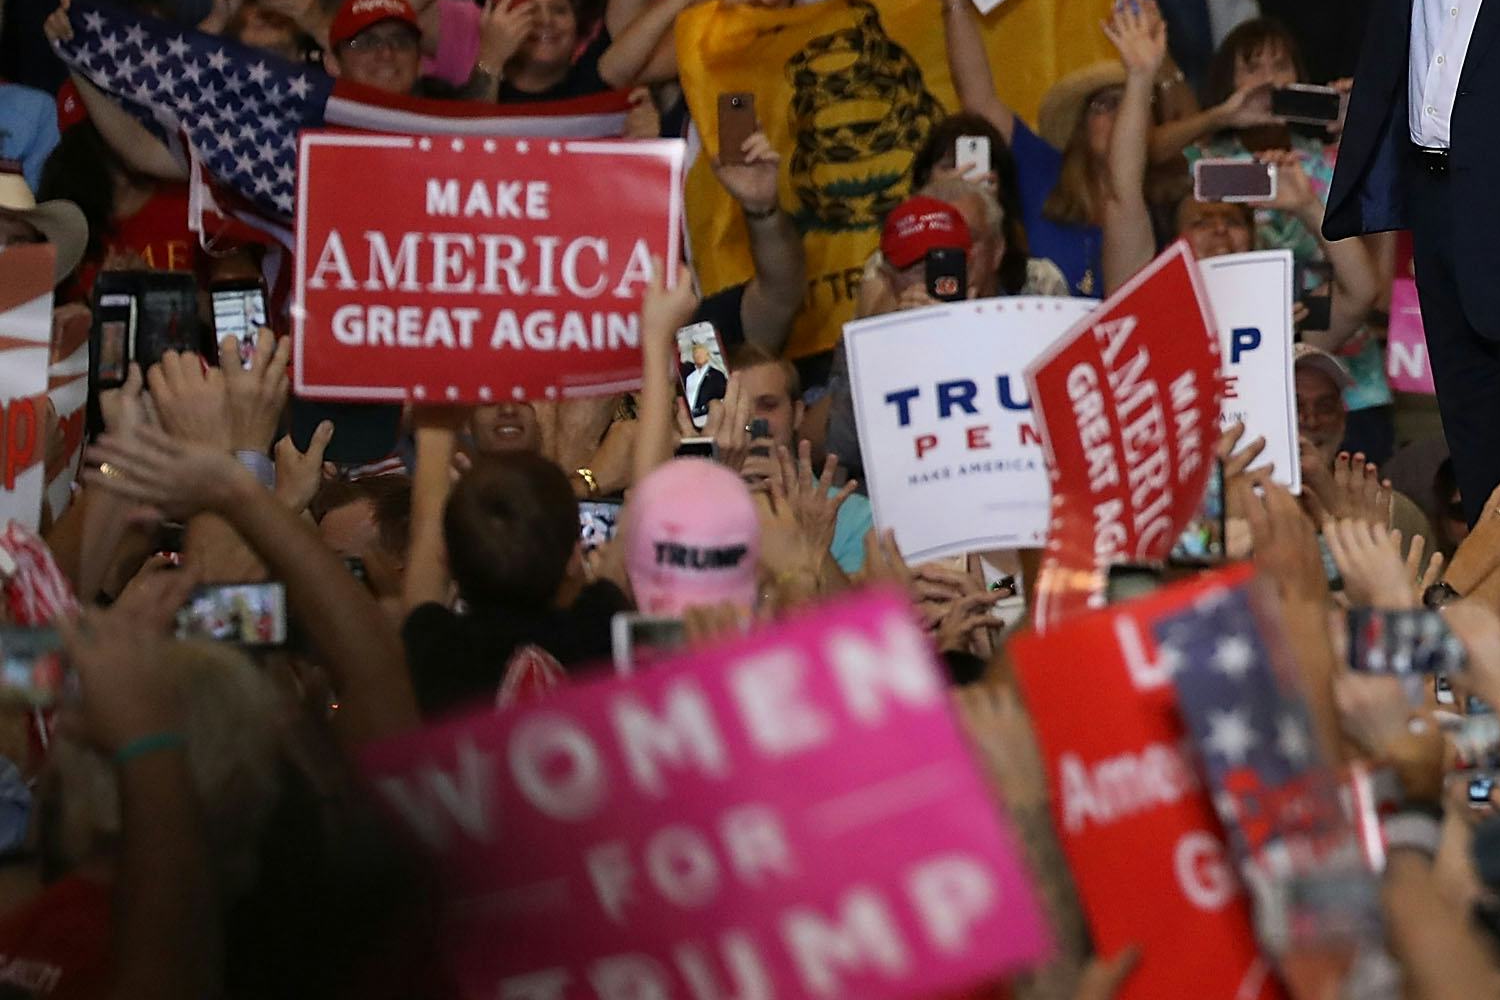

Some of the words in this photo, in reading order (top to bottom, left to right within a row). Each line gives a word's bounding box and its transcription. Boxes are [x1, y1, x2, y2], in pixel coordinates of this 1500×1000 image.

[425, 178, 551, 219] MAKE
[307, 228, 657, 300] AMERICA
[331, 303, 481, 349] GREAT
[489, 308, 641, 352] AGAIN
[885, 374, 1034, 428] TRU
[1066, 361, 1120, 493] GREAT
[1169, 370, 1200, 484] MAKE
[914, 422, 1044, 460] PEN
[958, 458, 1036, 476] AMERICA
[1091, 315, 1173, 562] AMERIC
[375, 610, 942, 850] WOMEN
[586, 803, 793, 924] FOR
